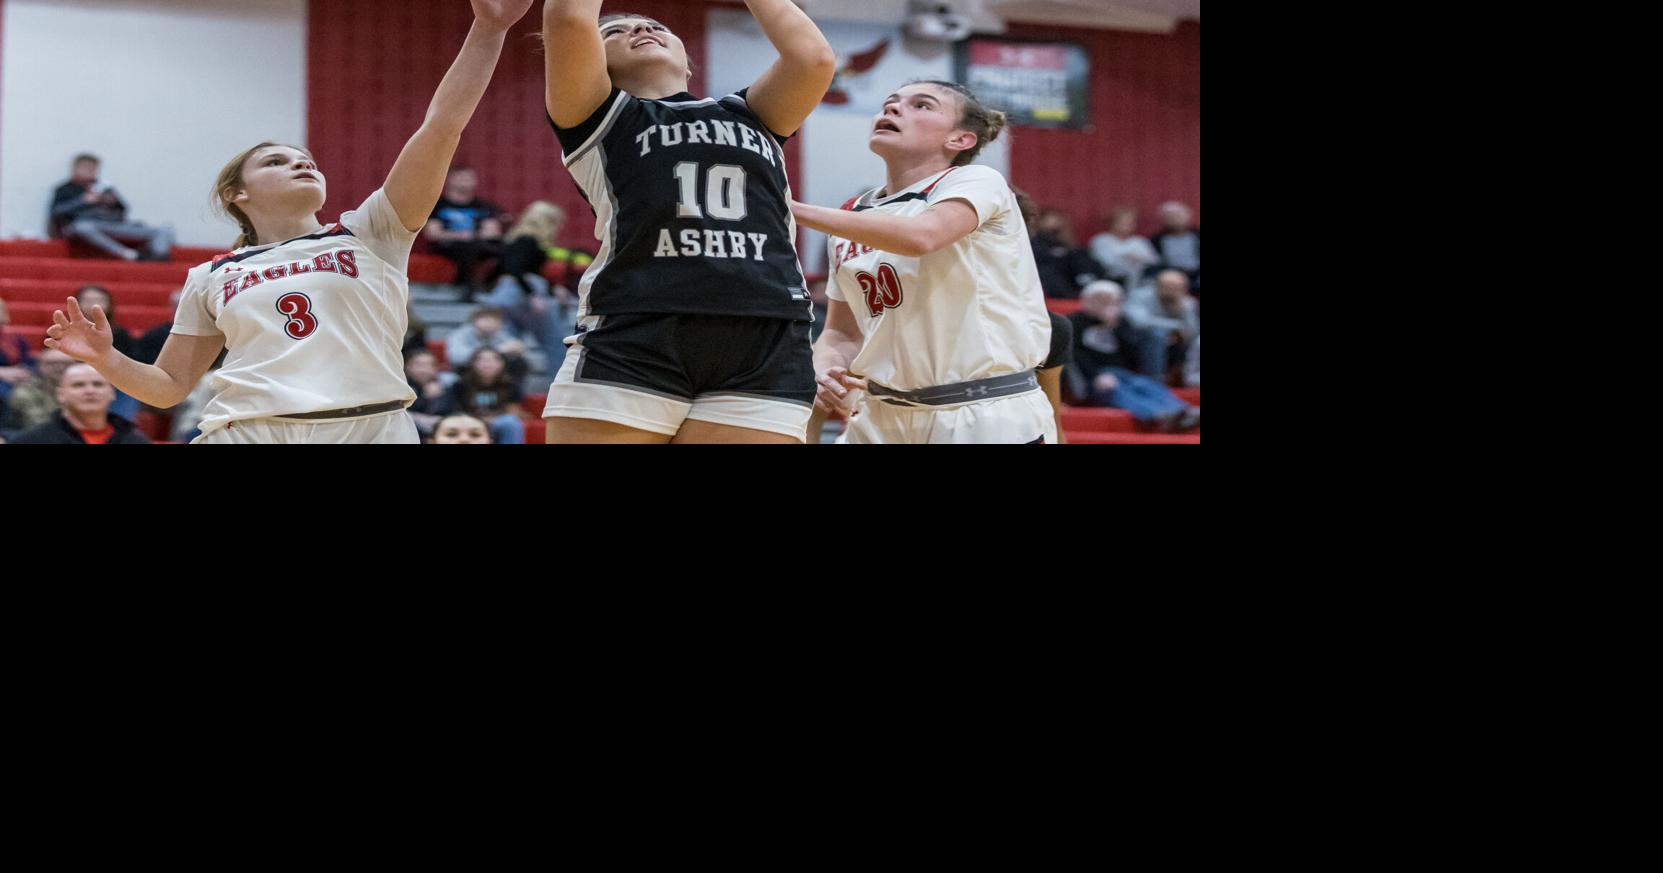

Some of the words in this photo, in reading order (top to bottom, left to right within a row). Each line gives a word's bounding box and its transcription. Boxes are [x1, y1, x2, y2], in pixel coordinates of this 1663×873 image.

[635, 119, 776, 167] TURNER
[673, 161, 747, 221] 10
[653, 228, 768, 261] ASHBY
[223, 250, 360, 307] EAGLES
[855, 263, 904, 318] 20
[276, 291, 319, 340] 3
